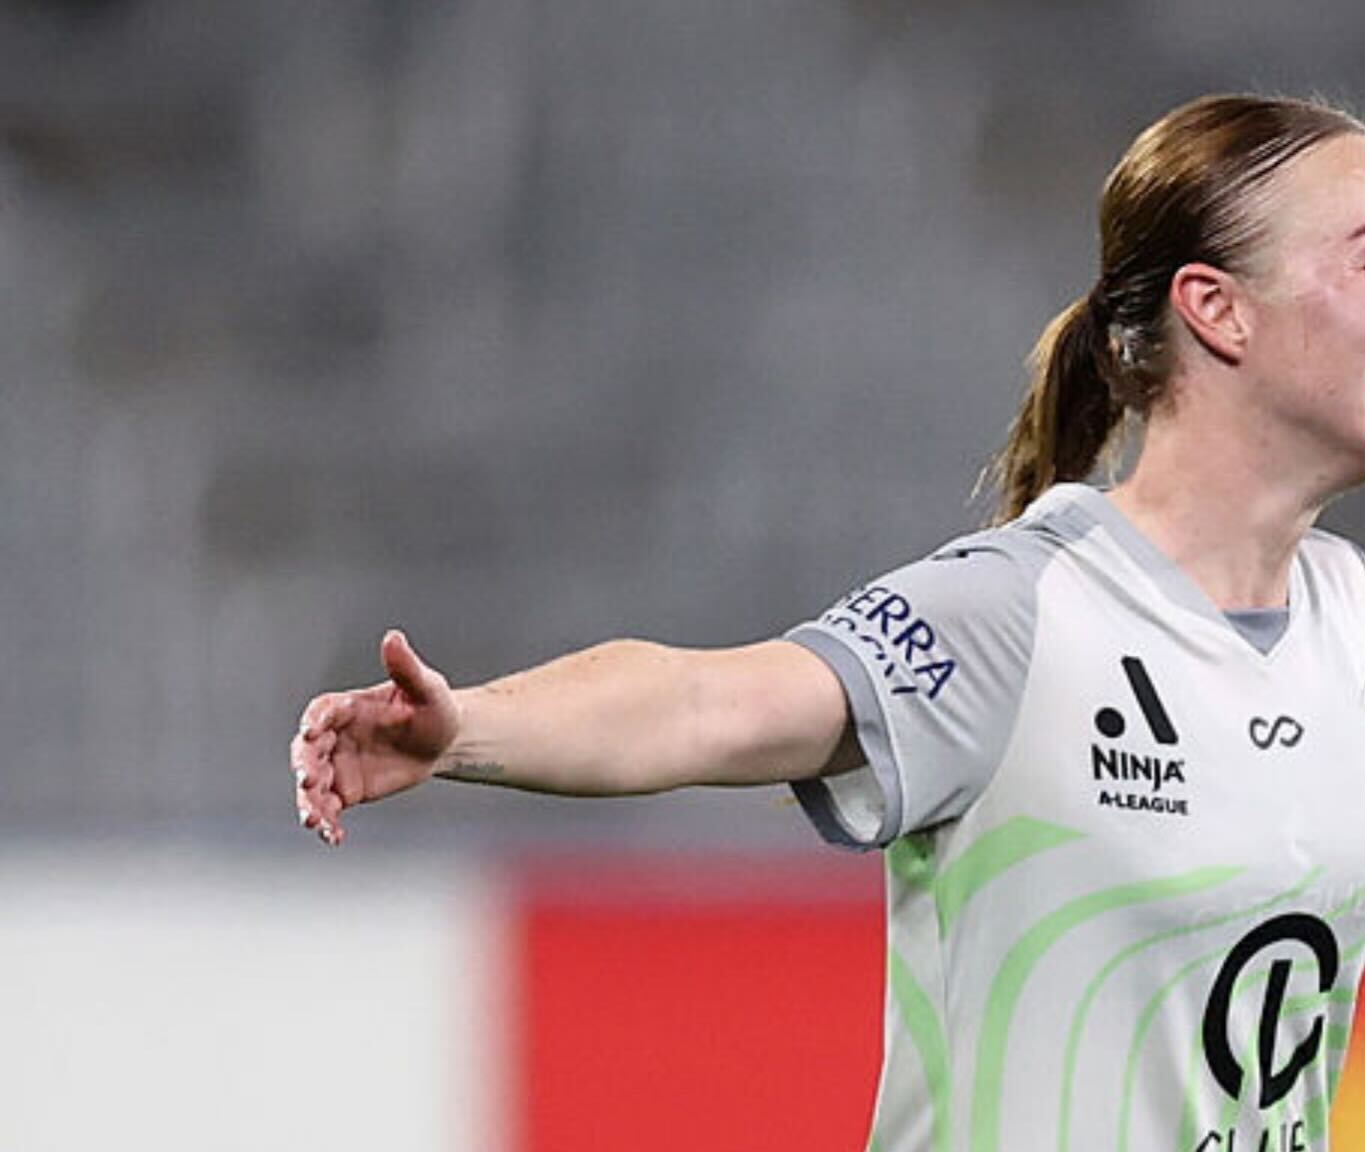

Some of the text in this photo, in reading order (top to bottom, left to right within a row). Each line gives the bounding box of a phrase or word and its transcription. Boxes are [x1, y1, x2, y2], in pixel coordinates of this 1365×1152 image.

[847, 586, 956, 700] ERRA
[1091, 743, 1186, 792] NINJA
[1098, 789, 1189, 817] A-LEAGUE
